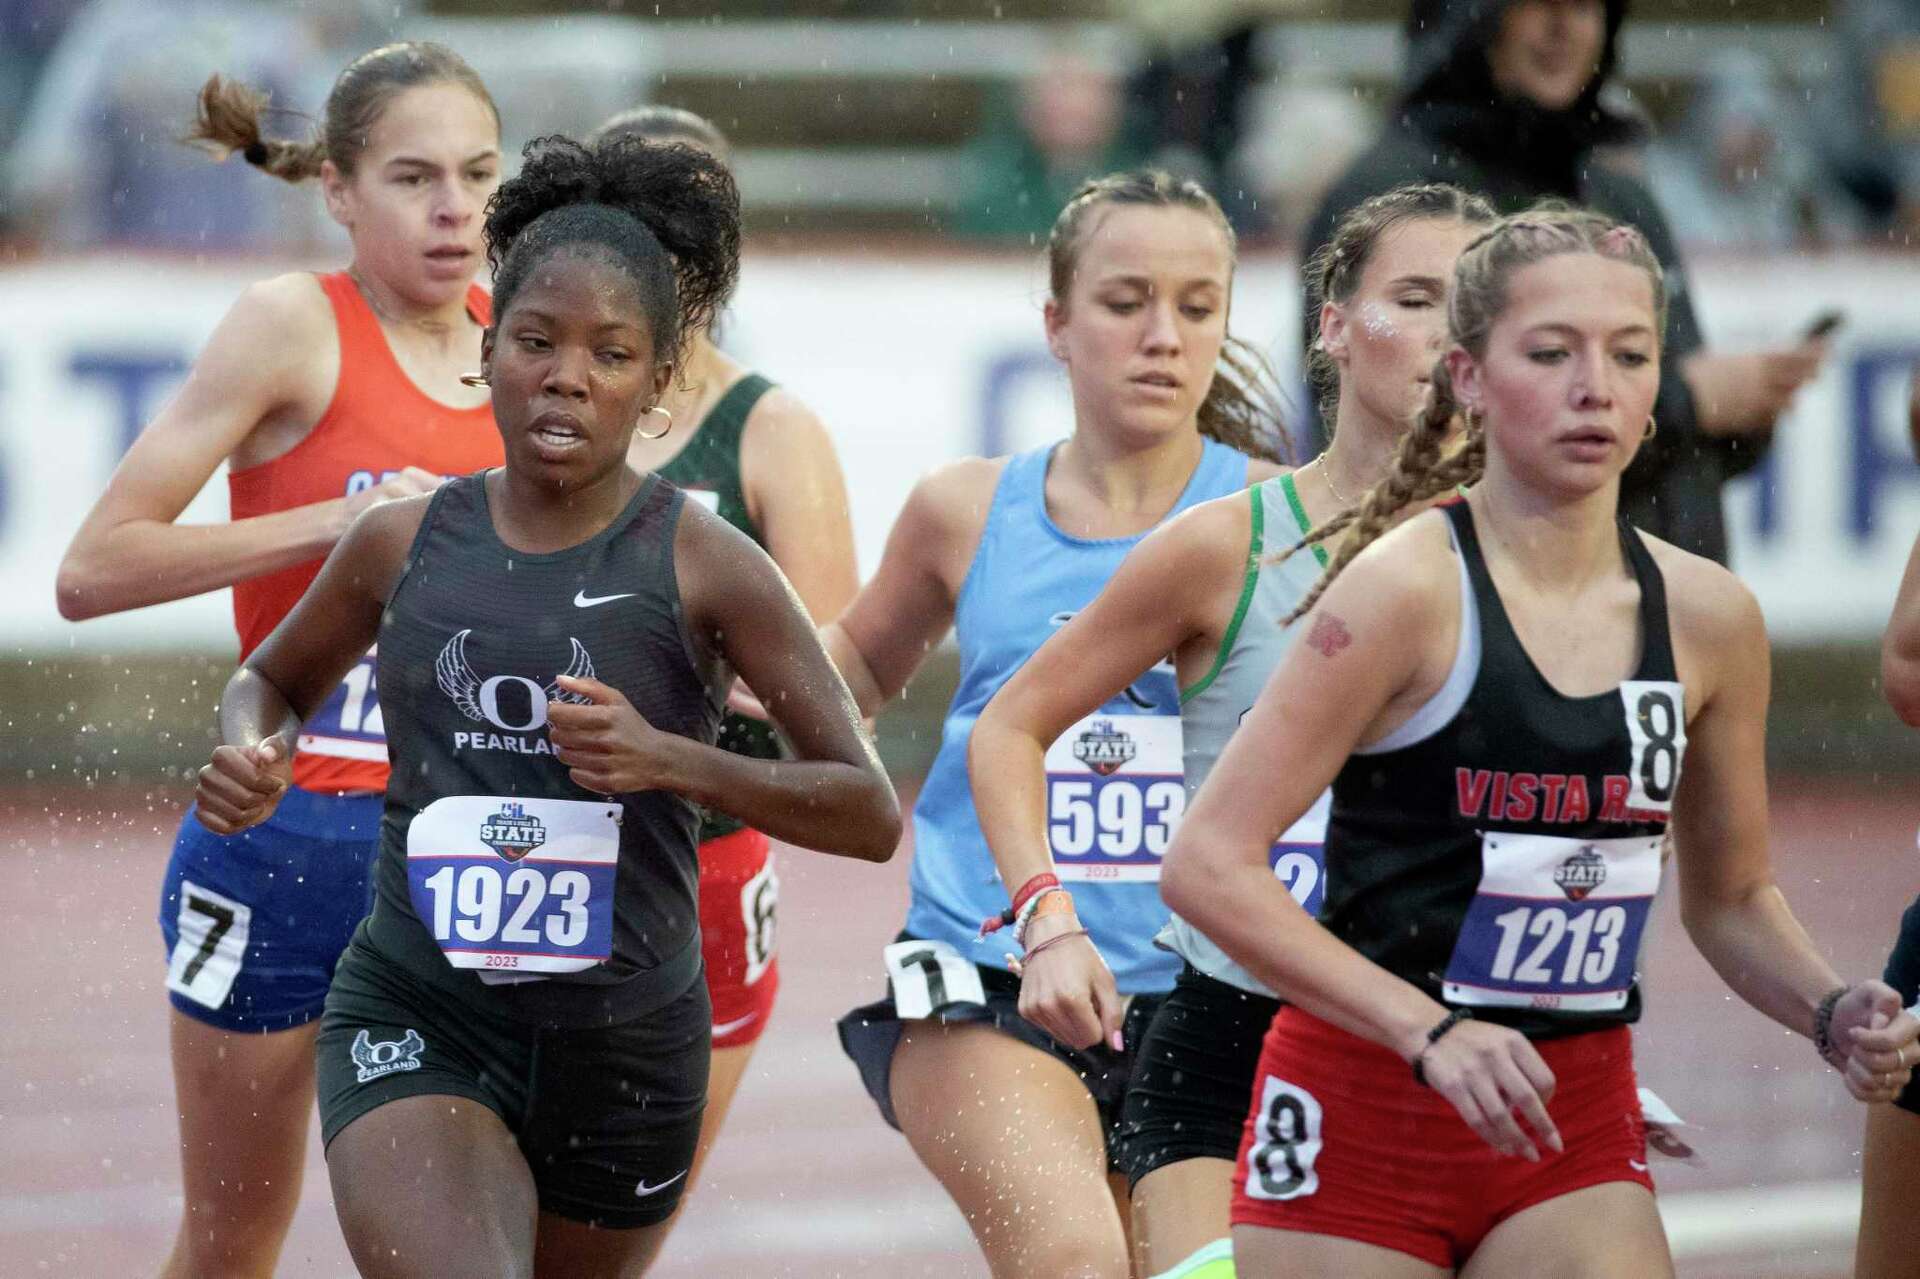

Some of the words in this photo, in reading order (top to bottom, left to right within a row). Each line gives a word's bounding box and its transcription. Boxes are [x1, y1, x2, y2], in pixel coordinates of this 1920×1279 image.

[1074, 741, 1136, 758] STATE
[1637, 690, 1677, 802] 8
[1456, 767, 1590, 823] VISTA
[481, 824, 546, 842] STATE
[424, 865, 591, 946] 1923
[1553, 865, 1606, 881] STATE
[180, 893, 235, 986] 7
[485, 955, 519, 968] 2023
[1490, 905, 1627, 984] 1213
[1255, 1093, 1307, 1195] 8
